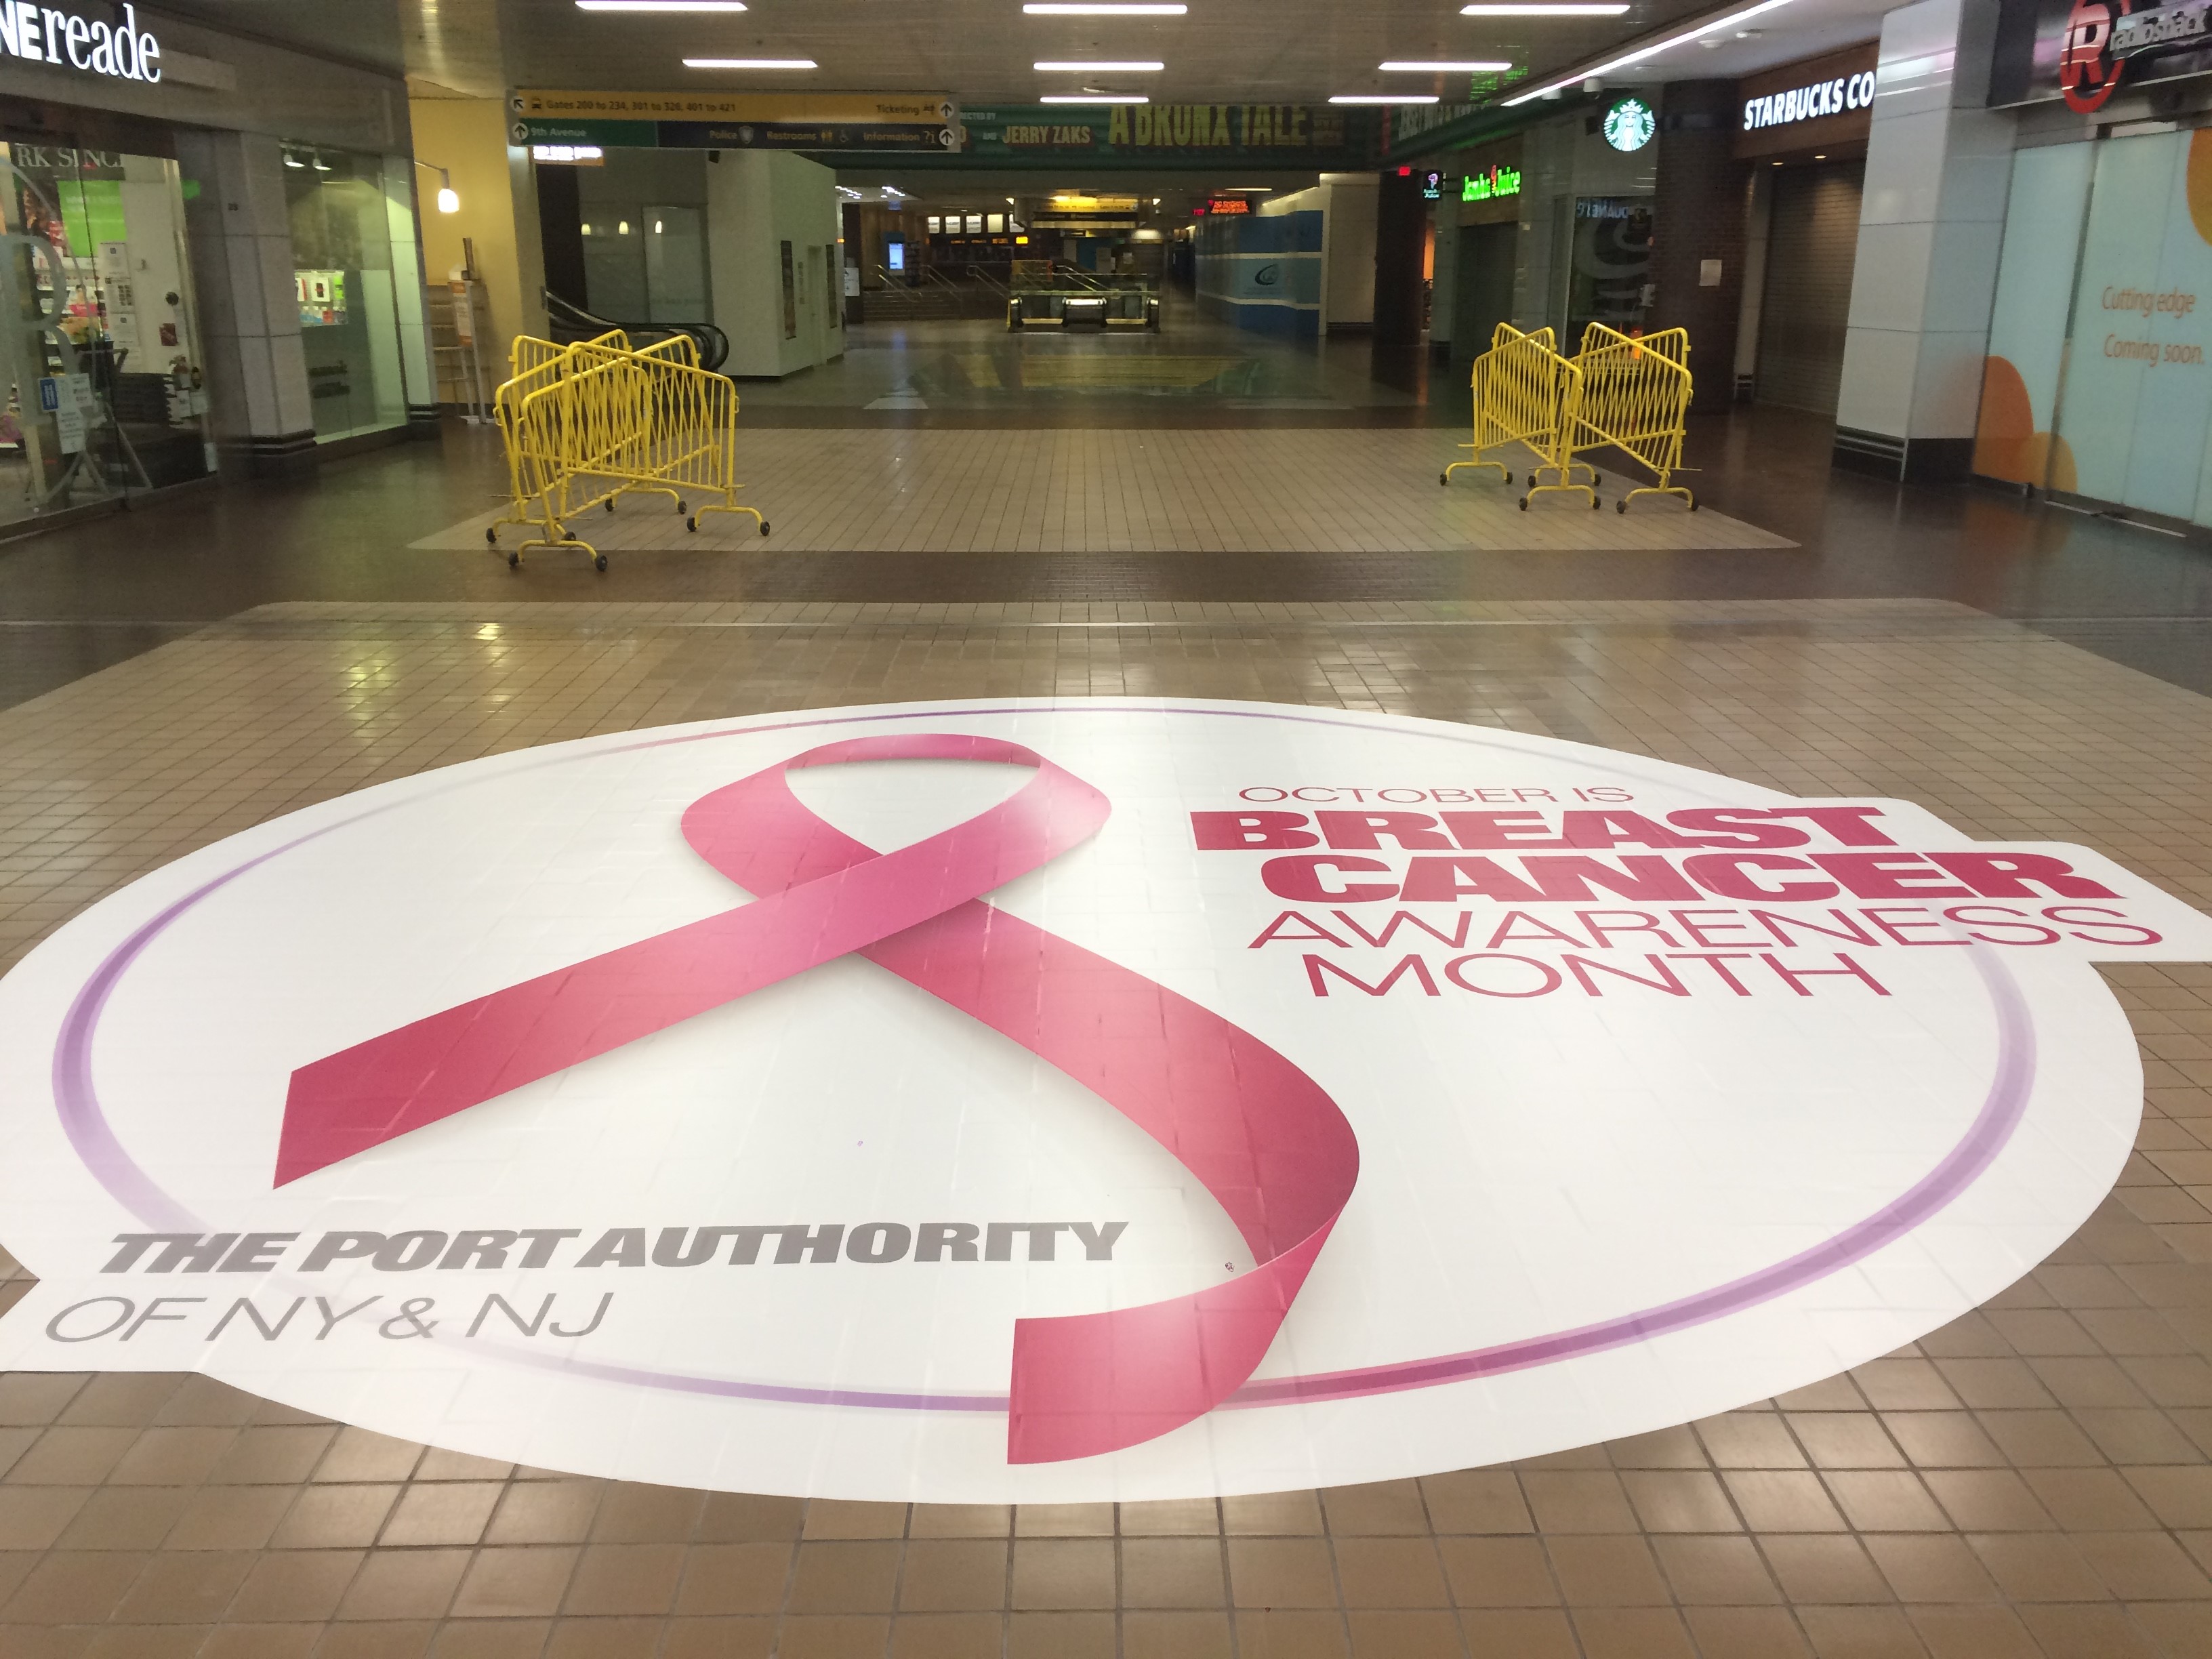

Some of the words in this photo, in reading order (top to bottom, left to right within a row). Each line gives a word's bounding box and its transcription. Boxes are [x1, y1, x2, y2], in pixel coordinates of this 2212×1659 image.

[546, 100, 573, 109] Gates
[596, 102, 606, 110] to
[706, 104, 716, 112] to
[876, 104, 920, 115] Ticketing
[1744, 78, 1845, 131] STARBUCKS
[1847, 71, 1875, 109] CO
[530, 127, 548, 136] 9th
[550, 127, 587, 137] Avenue
[710, 129, 737, 139] Police
[766, 130, 817, 141] Restrooms
[863, 130, 920, 141] Information
[1003, 125, 1049, 144] JERRY
[1051, 125, 1090, 144] ZAKS
[1495, 166, 1521, 197] Juice
[2103, 286, 2154, 318] Cutting
[2157, 287, 2196, 319] edge
[2104, 334, 2160, 367] Coming
[2164, 344, 2205, 365] soon.
[1239, 787, 1559, 802] OCTOBER
[1572, 787, 1635, 802] IS
[1191, 807, 1887, 851] BREAST
[1261, 853, 2125, 903] CANCER
[1249, 906, 2162, 949] AWARENESS
[1302, 953, 1890, 998] MONTH
[100, 1232, 302, 1273] THE
[298, 1228, 582, 1272] PORT
[574, 1221, 1128, 1268] AUTHORITY
[45, 1296, 208, 1343] OF
[205, 1295, 384, 1341] NY
[378, 1297, 440, 1339] &
[464, 1292, 614, 1338] NJ
